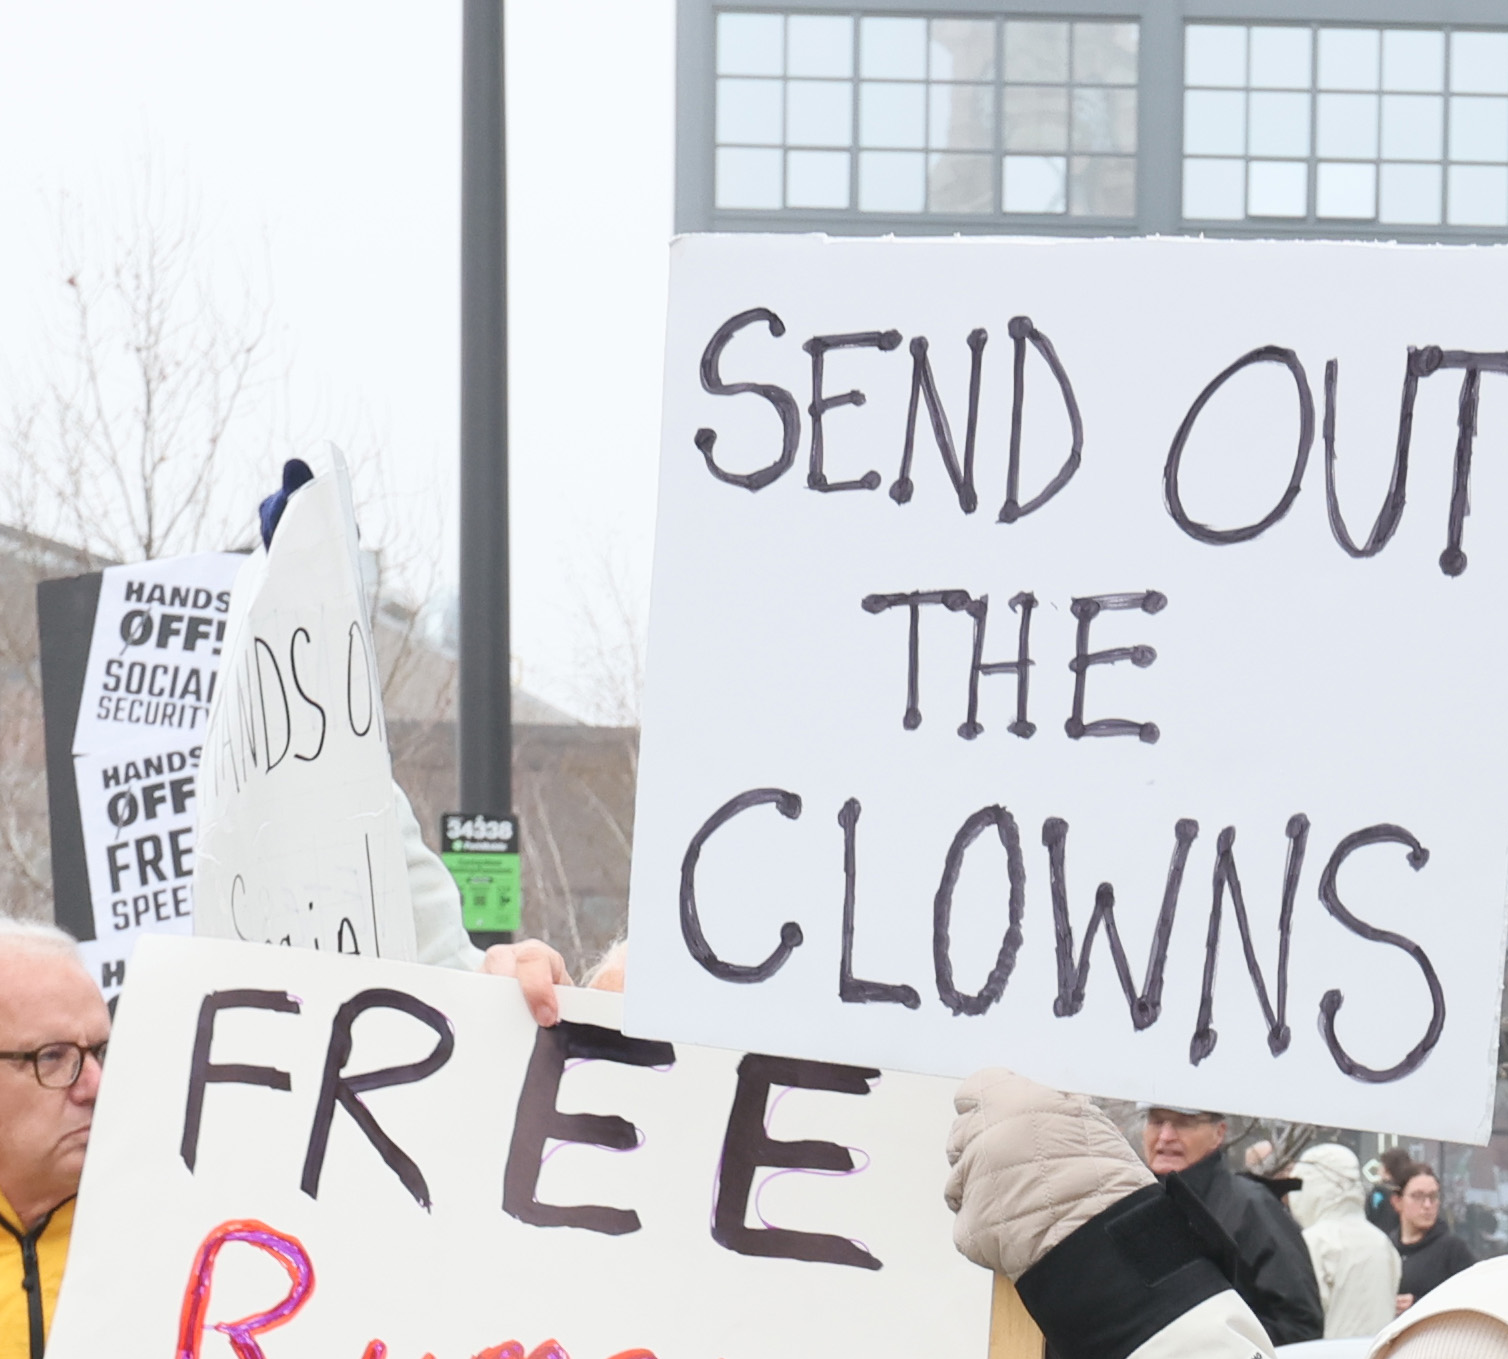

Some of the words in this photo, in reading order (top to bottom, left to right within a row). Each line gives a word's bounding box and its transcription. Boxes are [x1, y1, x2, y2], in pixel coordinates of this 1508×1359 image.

[694, 307, 1084, 523] SEND
[124, 580, 231, 613] HANDS
[861, 588, 1168, 741] THE
[102, 745, 203, 789] HANDS
[106, 827, 195, 893] FRE
[112, 885, 192, 931] SPEE
[679, 786, 1446, 1084] CLOWNS
[180, 986, 883, 1272] FREE
